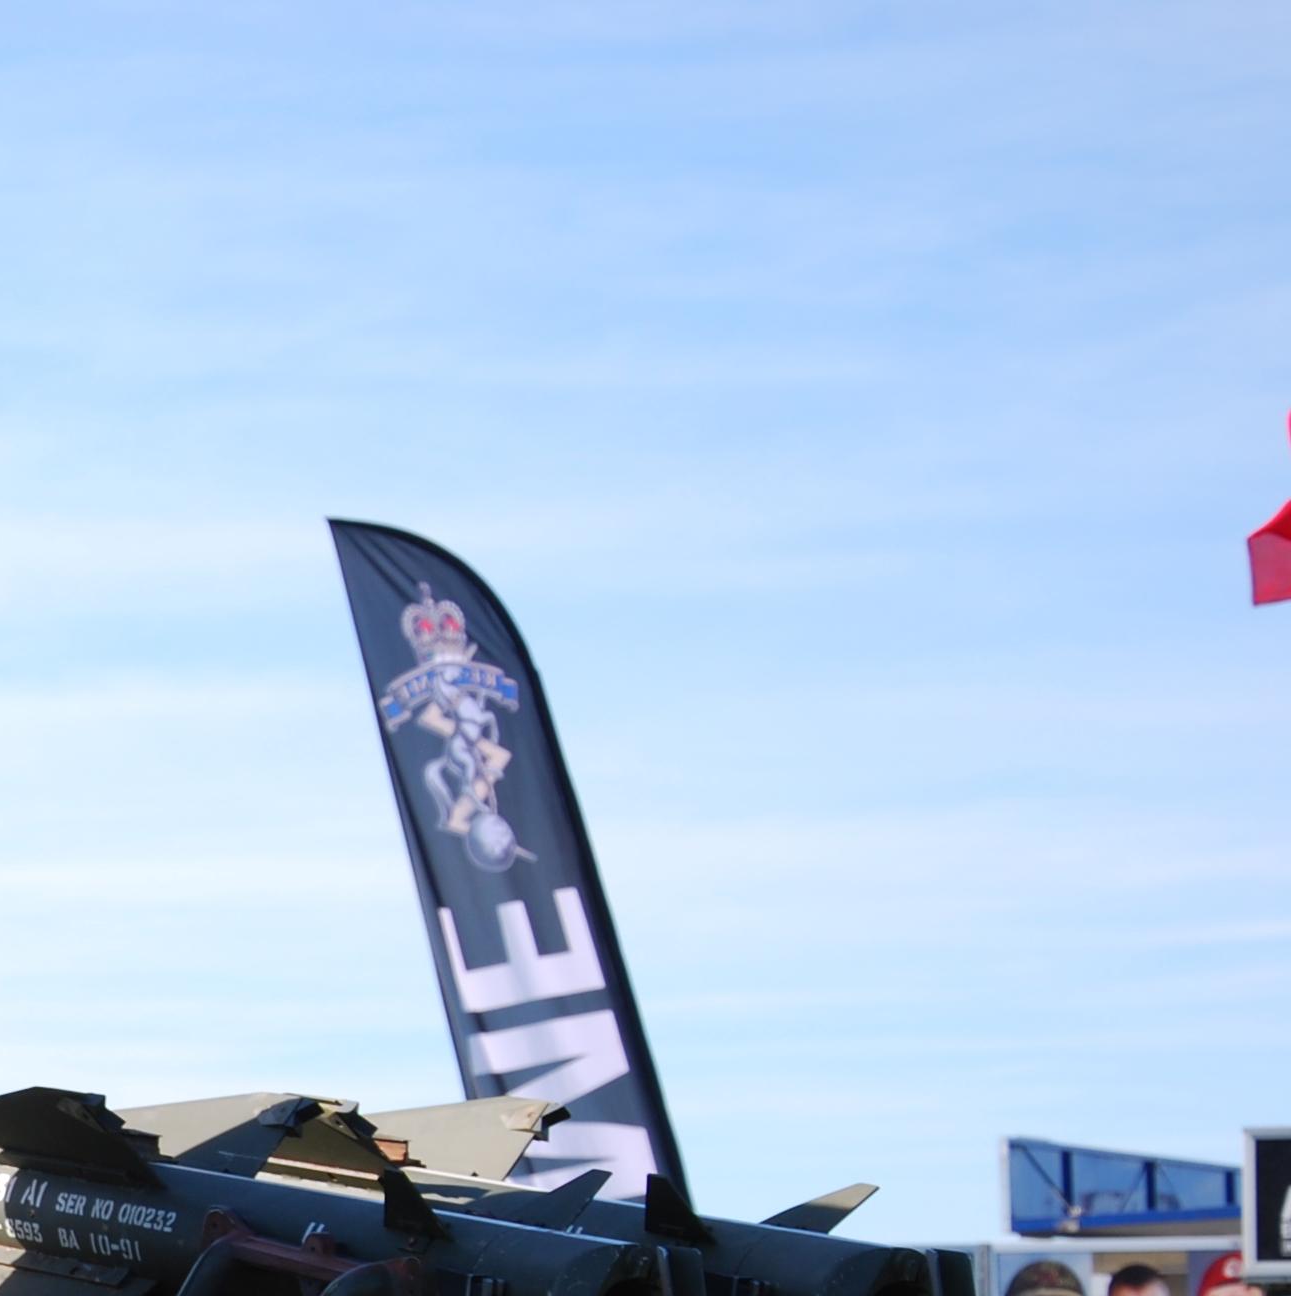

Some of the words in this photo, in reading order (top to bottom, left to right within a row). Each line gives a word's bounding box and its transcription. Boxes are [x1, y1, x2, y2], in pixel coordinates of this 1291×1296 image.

[55, 1191, 87, 1216] SER
[118, 1201, 176, 1233] 010232
[58, 1227, 80, 1250] BA
